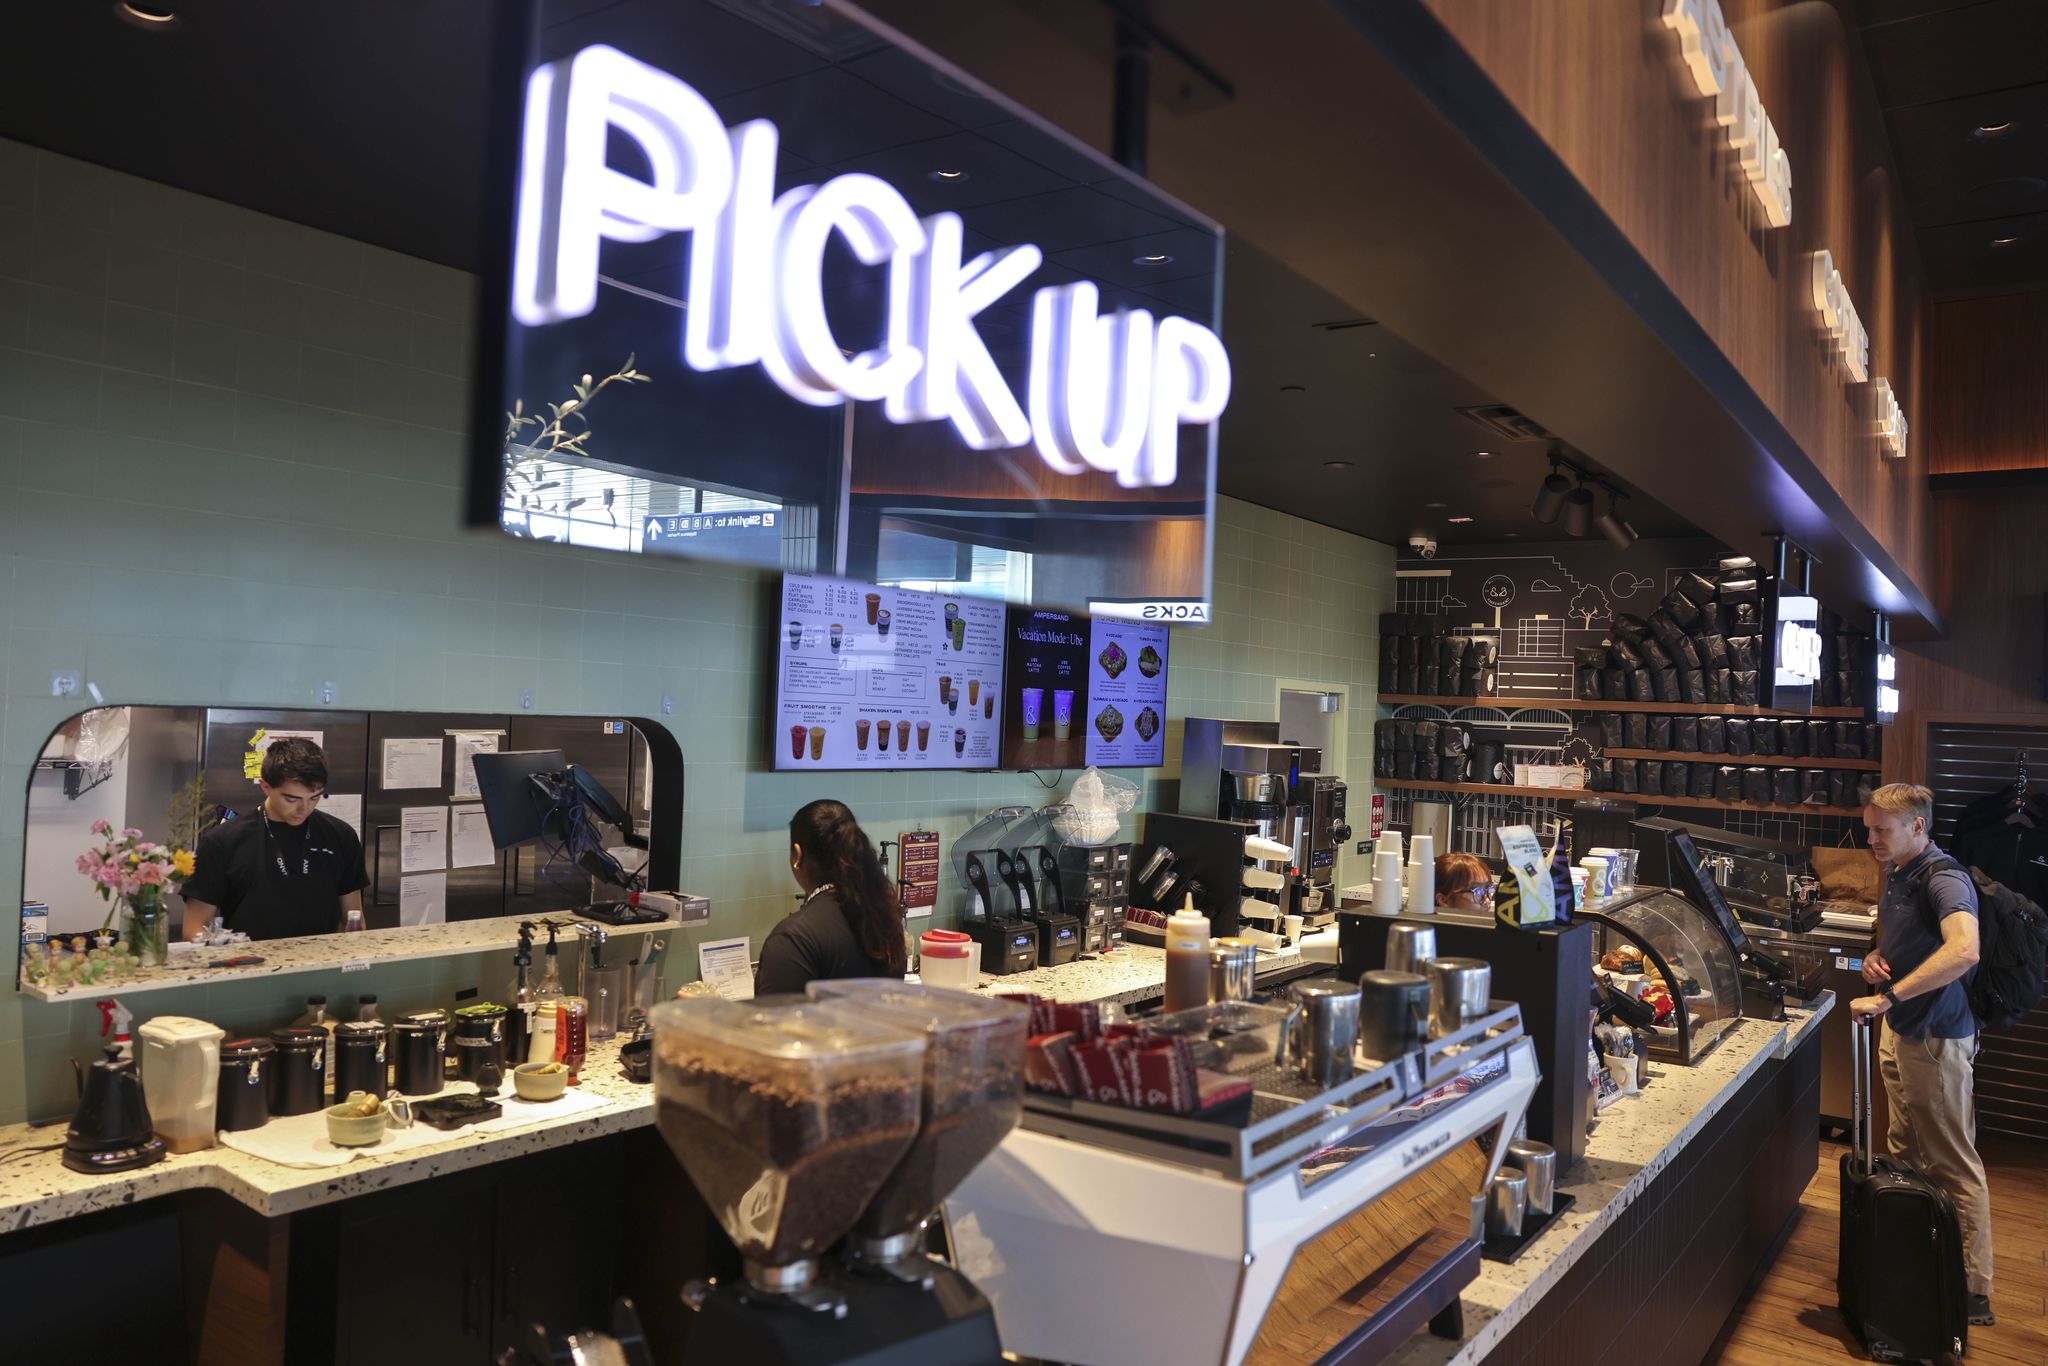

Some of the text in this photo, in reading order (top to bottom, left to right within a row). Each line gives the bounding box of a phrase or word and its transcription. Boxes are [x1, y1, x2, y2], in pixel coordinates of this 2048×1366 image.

[1662, 0, 1792, 228] ASTRIES
[512, 43, 1232, 489] PICK UP
[1017, 627, 1047, 642] Vacation
[1070, 634, 1084, 646] Ube
[1034, 611, 1070, 622] AMPERSAND
